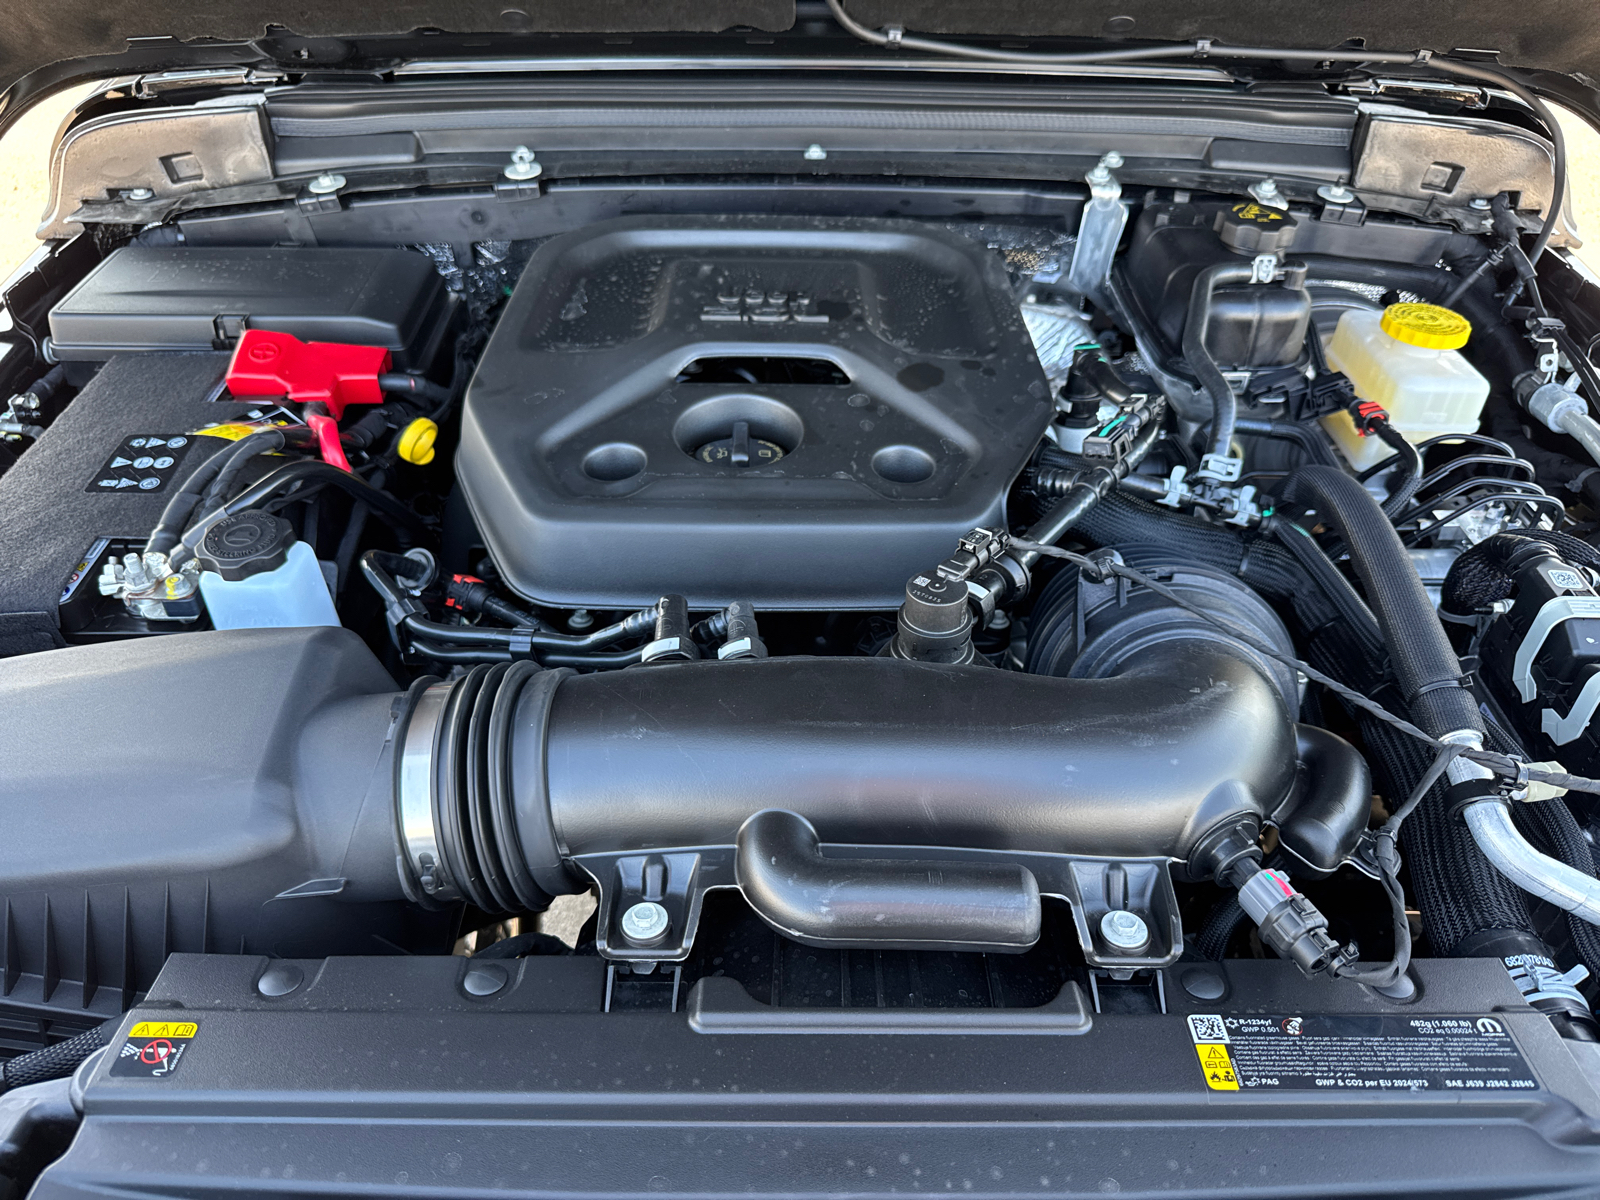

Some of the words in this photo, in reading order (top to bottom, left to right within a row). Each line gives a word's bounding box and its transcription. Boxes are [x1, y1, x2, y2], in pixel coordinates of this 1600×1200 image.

[1239, 1018, 1272, 1026] R-1234yf
[1445, 1027, 1473, 1035] 0.00024
[1316, 1079, 1336, 1087] GWP
[1338, 1079, 1345, 1087] &
[1345, 1079, 1364, 1087] CO2
[1365, 1080, 1378, 1088] per
[1446, 1080, 1464, 1088] SAE
[1465, 1080, 1485, 1088] J639
[1486, 1080, 1509, 1088] J2842
